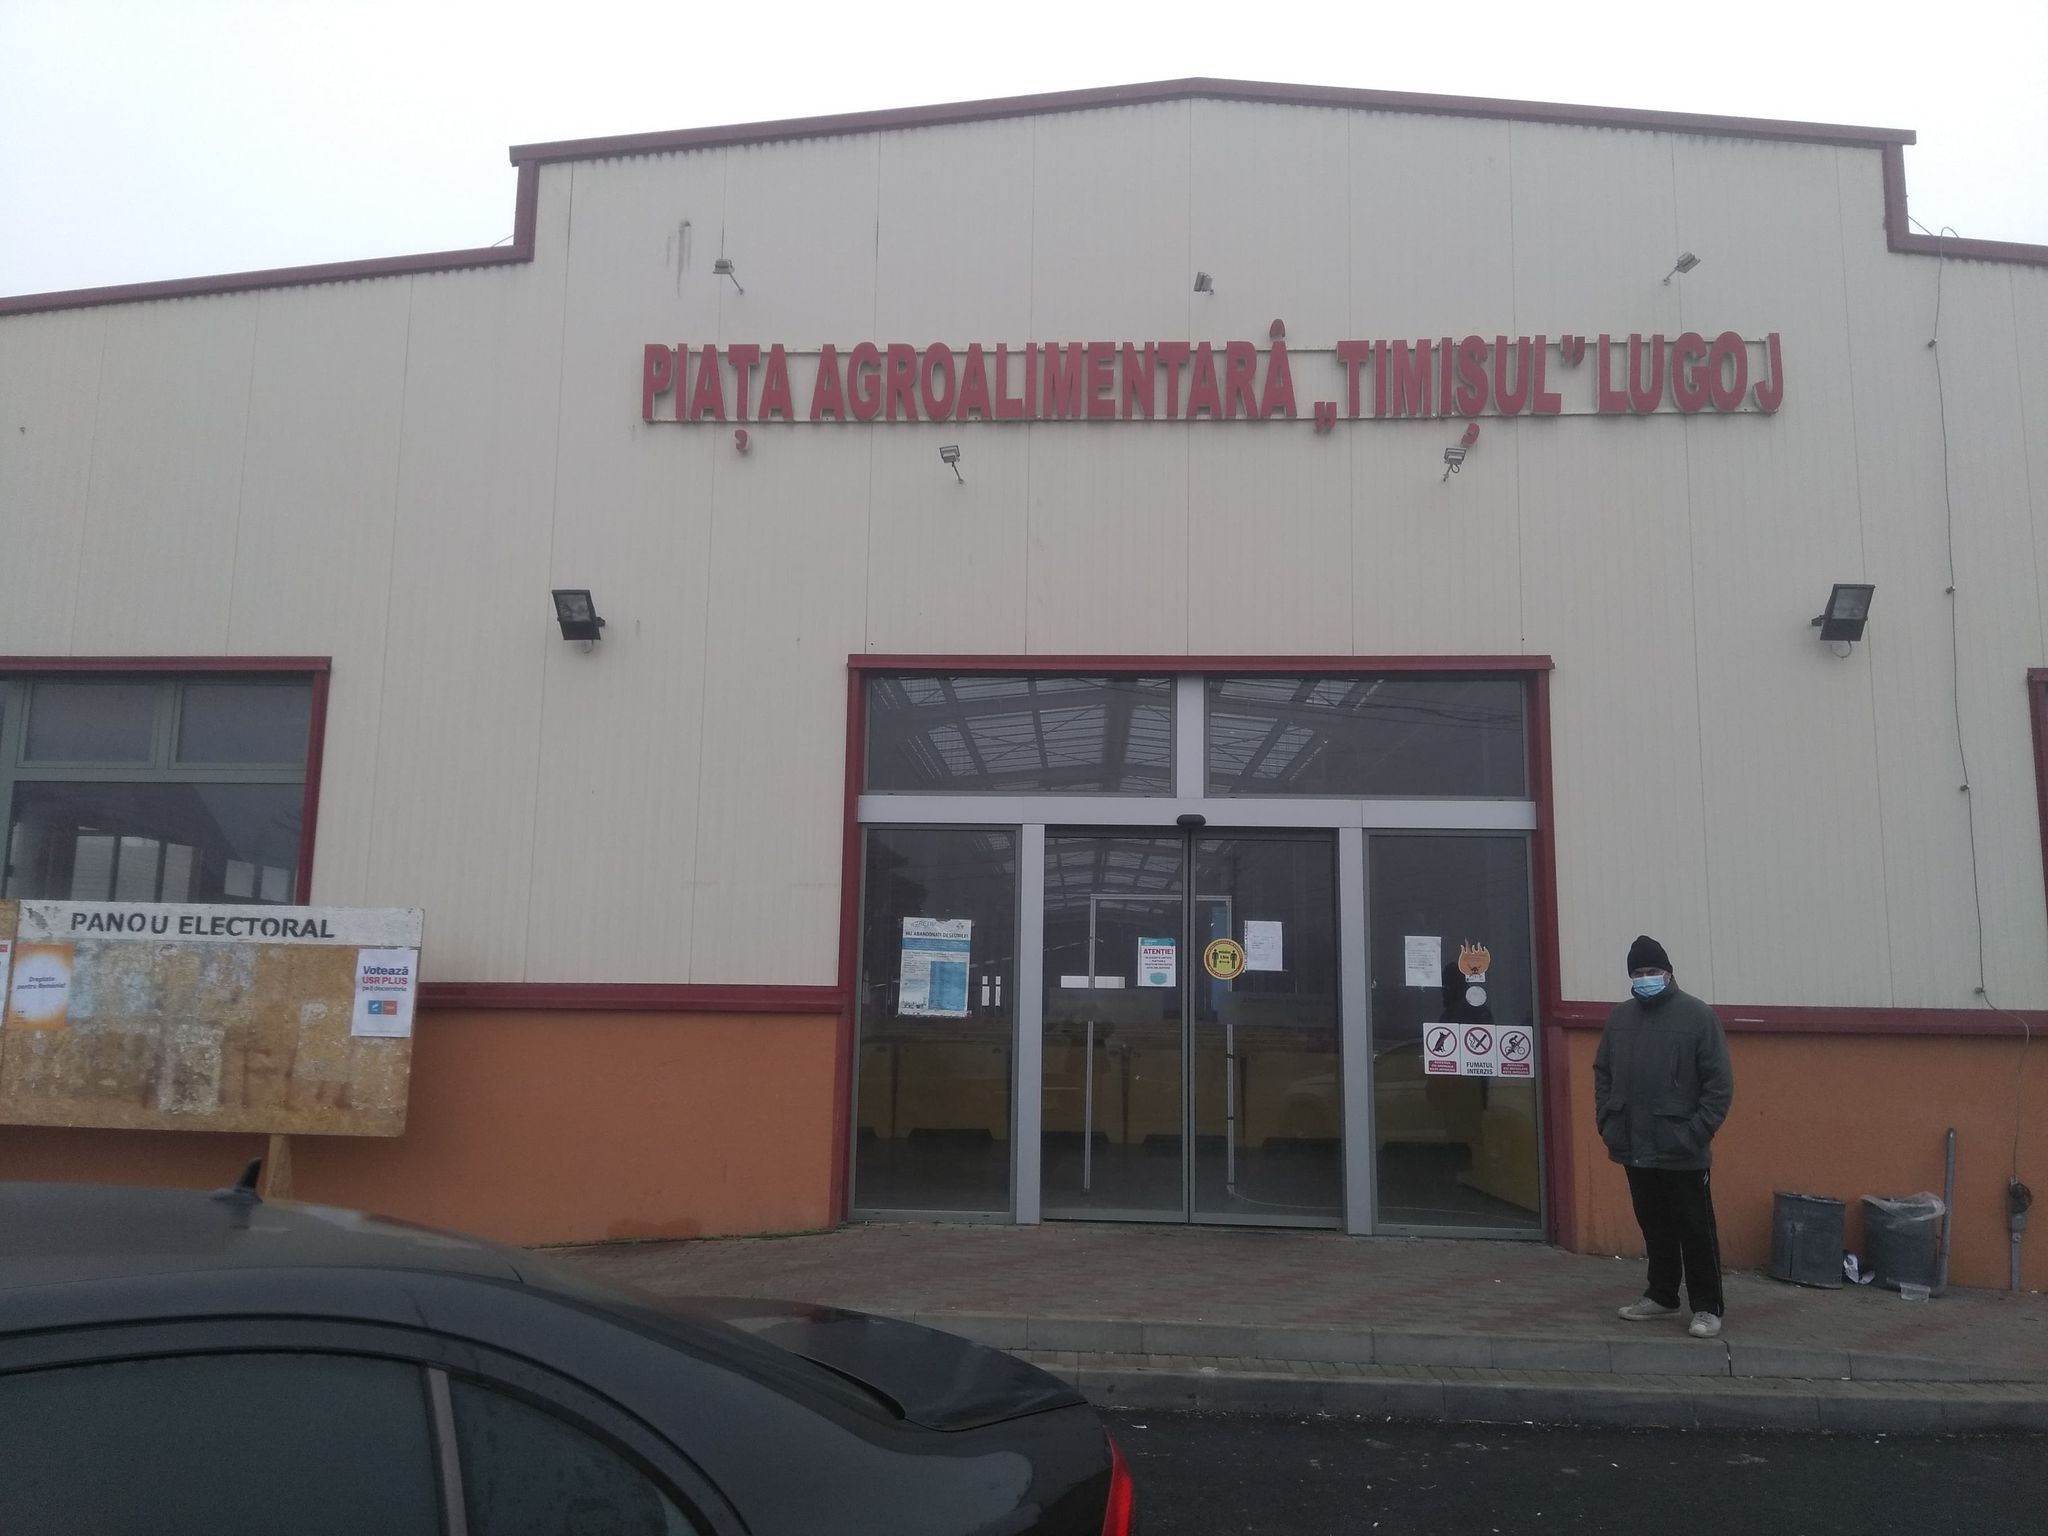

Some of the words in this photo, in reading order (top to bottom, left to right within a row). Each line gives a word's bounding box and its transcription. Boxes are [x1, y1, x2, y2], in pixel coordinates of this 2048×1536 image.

[1598, 331, 1783, 414] LUGOJ
[71, 912, 168, 935] PANOU
[179, 916, 335, 938] ELECTORAL
[363, 966, 409, 976] Votează
[362, 976, 380, 985] USR
[382, 977, 408, 985] PLUS
